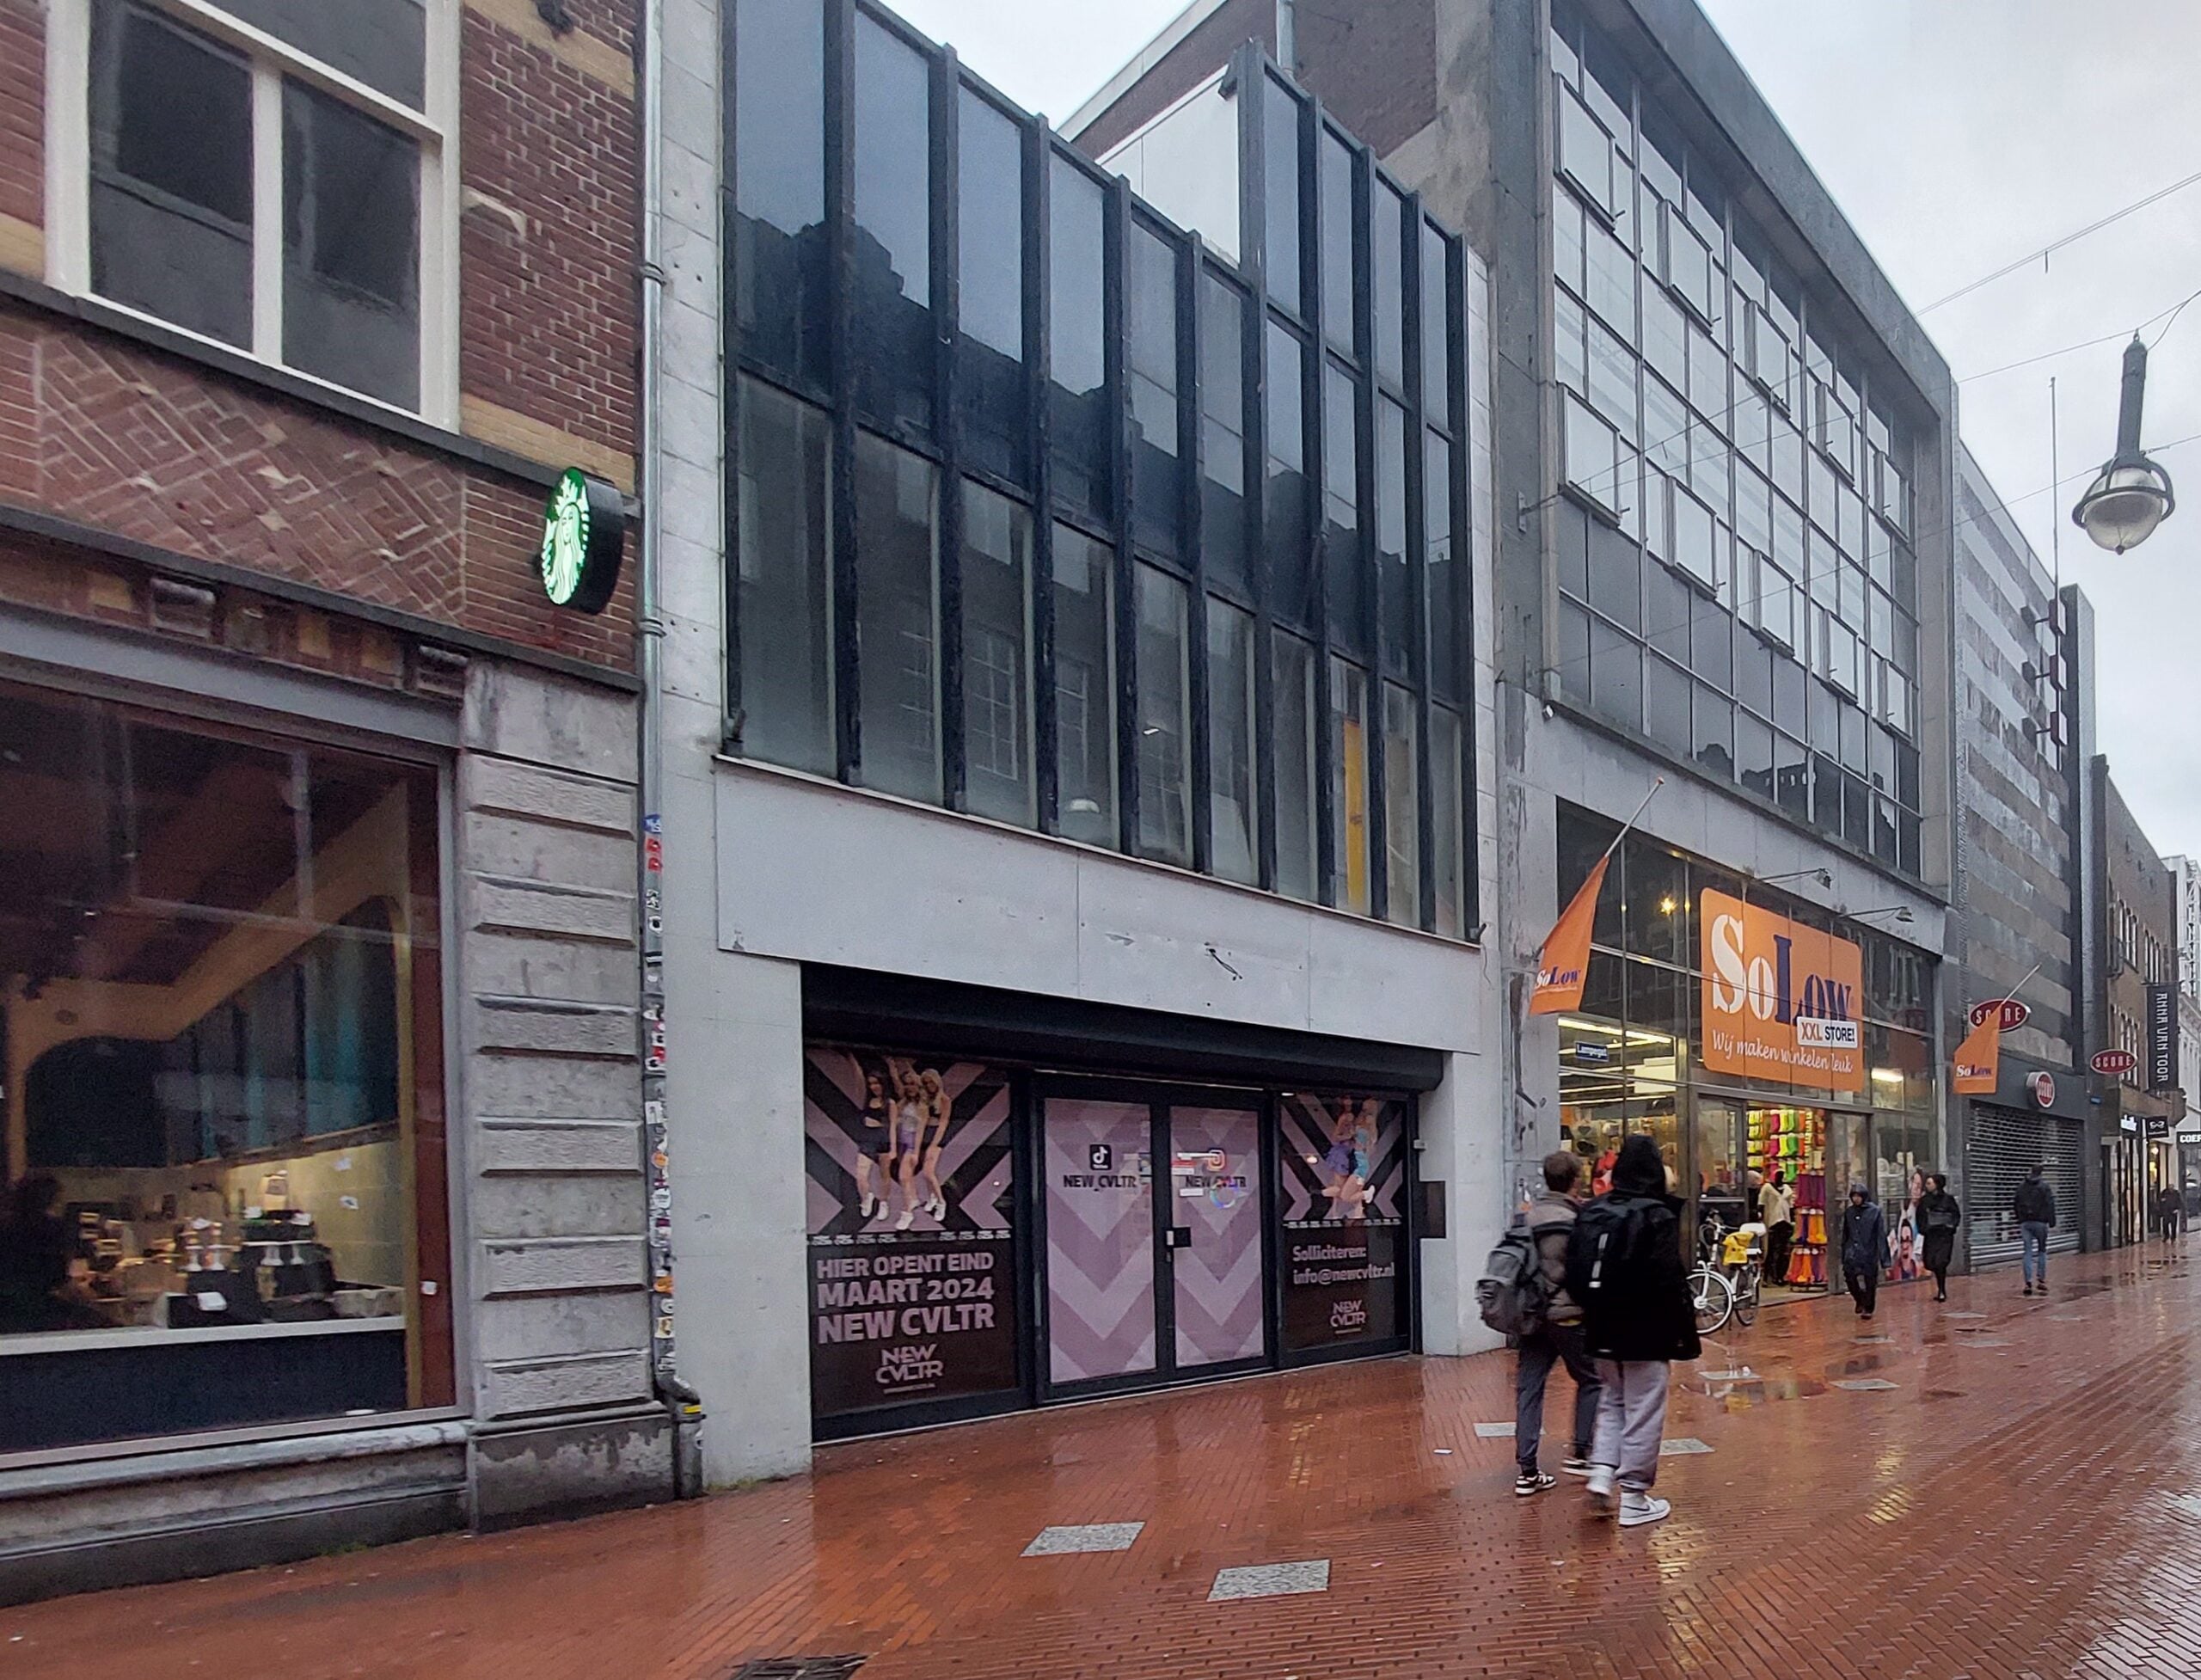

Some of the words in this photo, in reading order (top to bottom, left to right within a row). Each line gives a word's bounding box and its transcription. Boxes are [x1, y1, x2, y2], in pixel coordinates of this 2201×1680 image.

[1801, 1022, 1822, 1041] XXL
[1824, 1026, 1855, 1042] STORE!
[1713, 1030, 1734, 1059] Wij
[1737, 1038, 1779, 1060] maken
[1781, 1047, 1829, 1068] winkelen
[1830, 1052, 1853, 1073] leuk
[2094, 1055, 2131, 1068] SCORE
[2156, 1053, 2169, 1082] TOOR
[1292, 1244, 1366, 1261] Solliciteren:
[818, 1258, 869, 1278] HIER
[874, 1254, 944, 1275] OPENT
[947, 1252, 994, 1272] EIND
[818, 1278, 923, 1309] MAART
[927, 1276, 995, 1301] 2024
[1333, 1299, 1363, 1315] NEW
[818, 1309, 896, 1344] NEW
[901, 1303, 995, 1335] CVLTR
[1330, 1311, 1365, 1327] CVLTR
[881, 1343, 937, 1365] NEW
[875, 1360, 943, 1383] CVLTR
